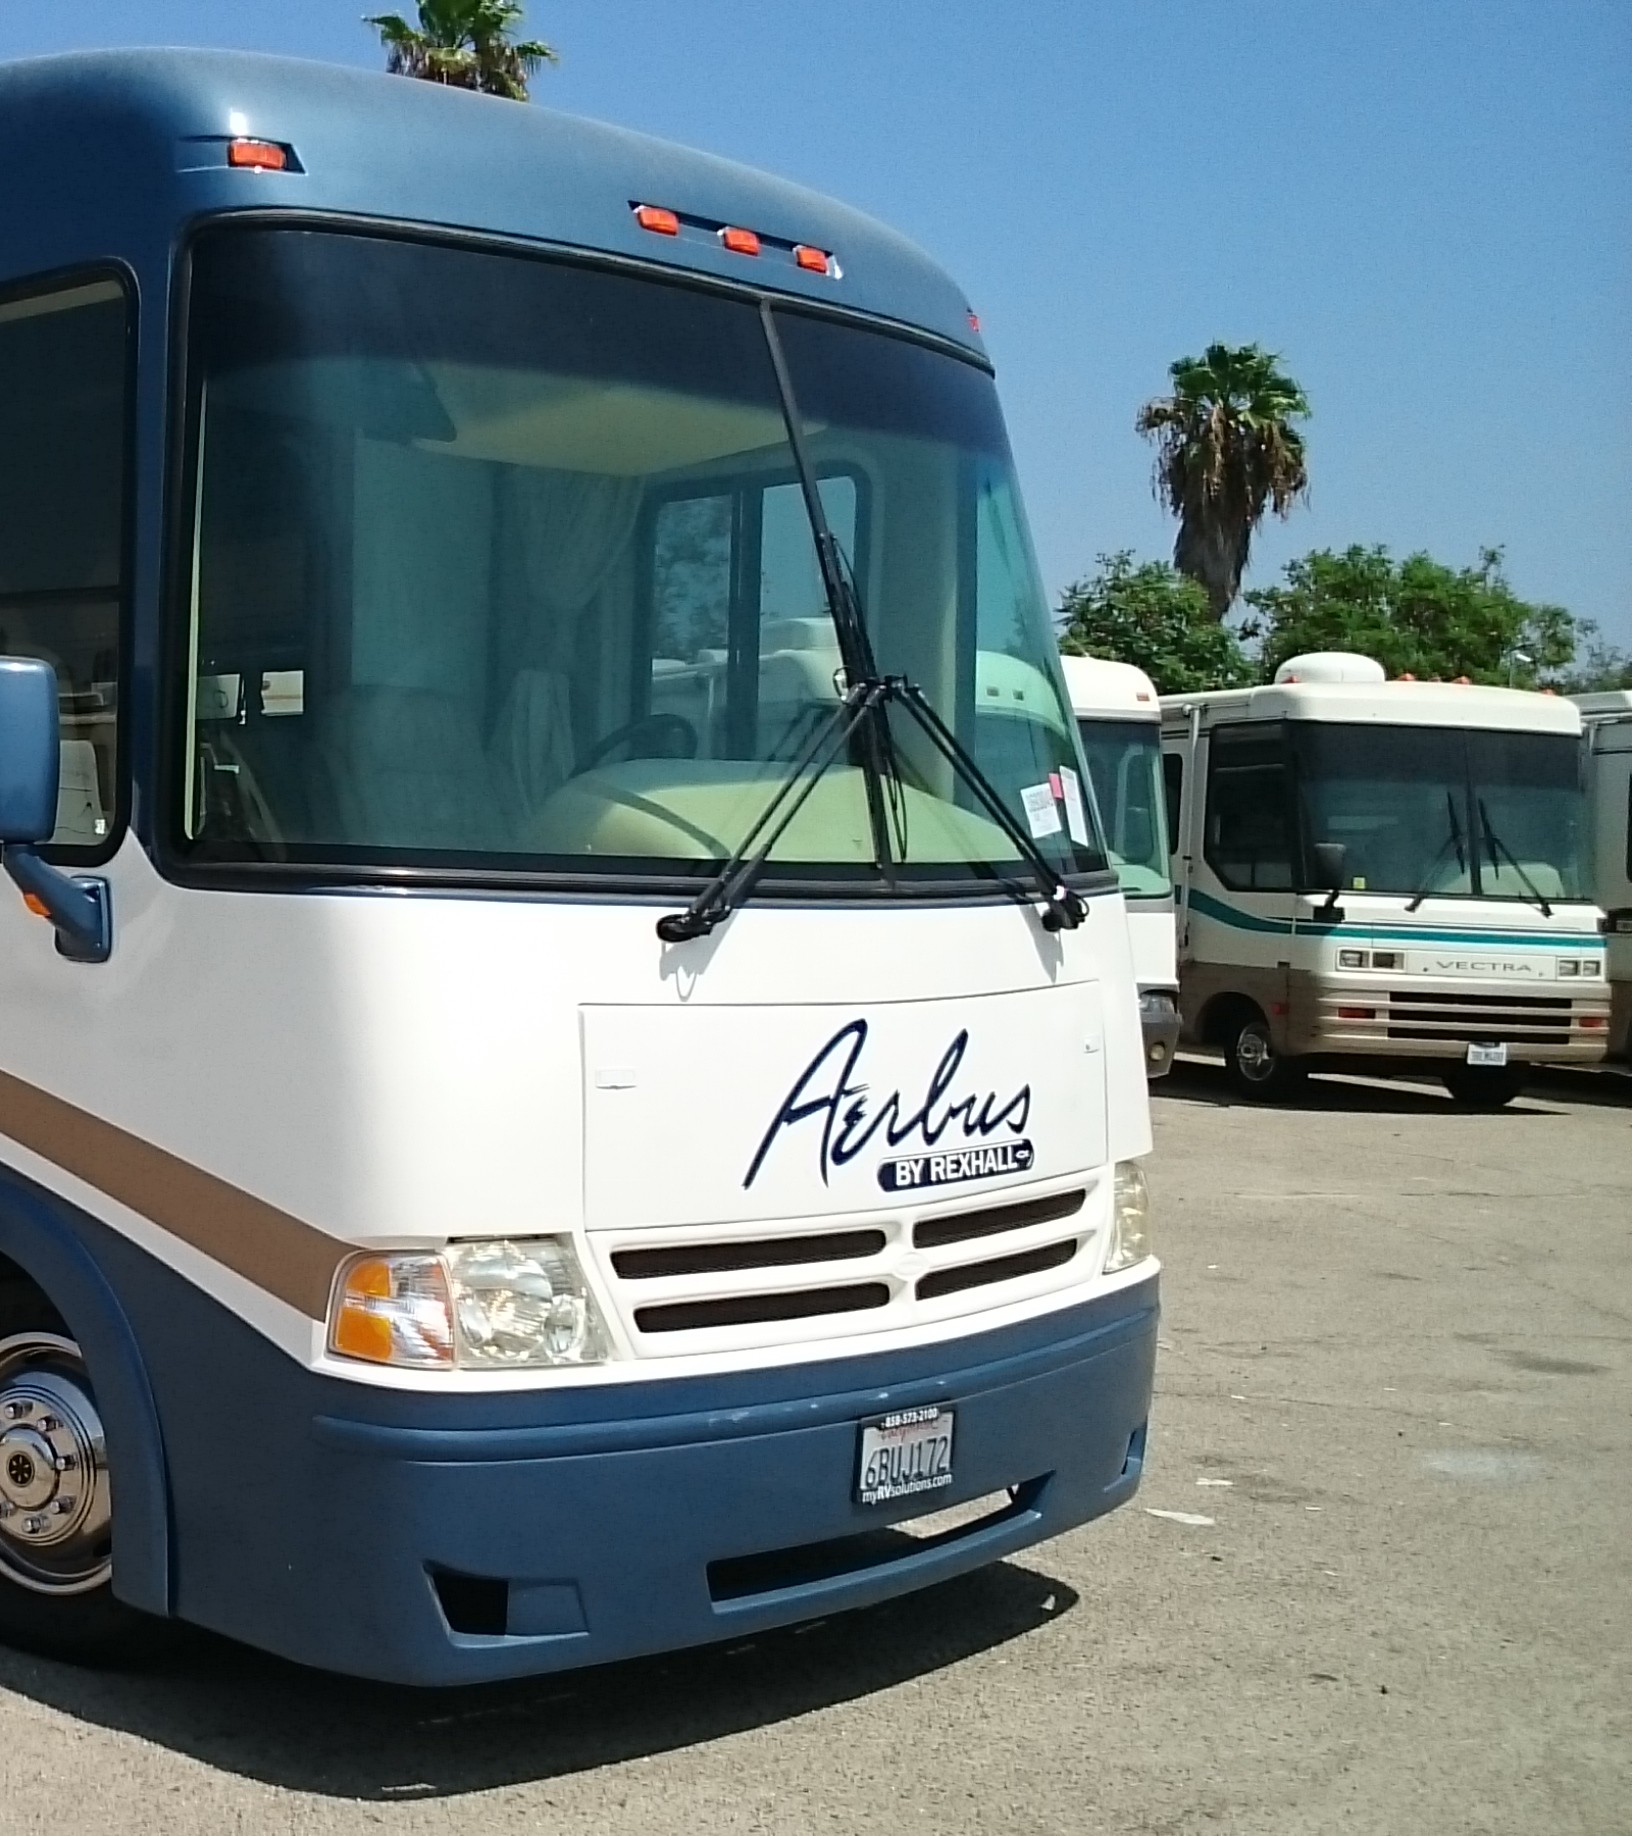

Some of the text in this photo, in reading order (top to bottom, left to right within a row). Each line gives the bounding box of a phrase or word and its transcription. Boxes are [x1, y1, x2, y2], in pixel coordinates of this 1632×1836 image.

[1436, 961, 1532, 971] VECTRA
[741, 1018, 1031, 1190] Aerbus
[895, 1146, 1018, 1187] BY REXHALL
[866, 1436, 948, 1488] 6BUJ172
